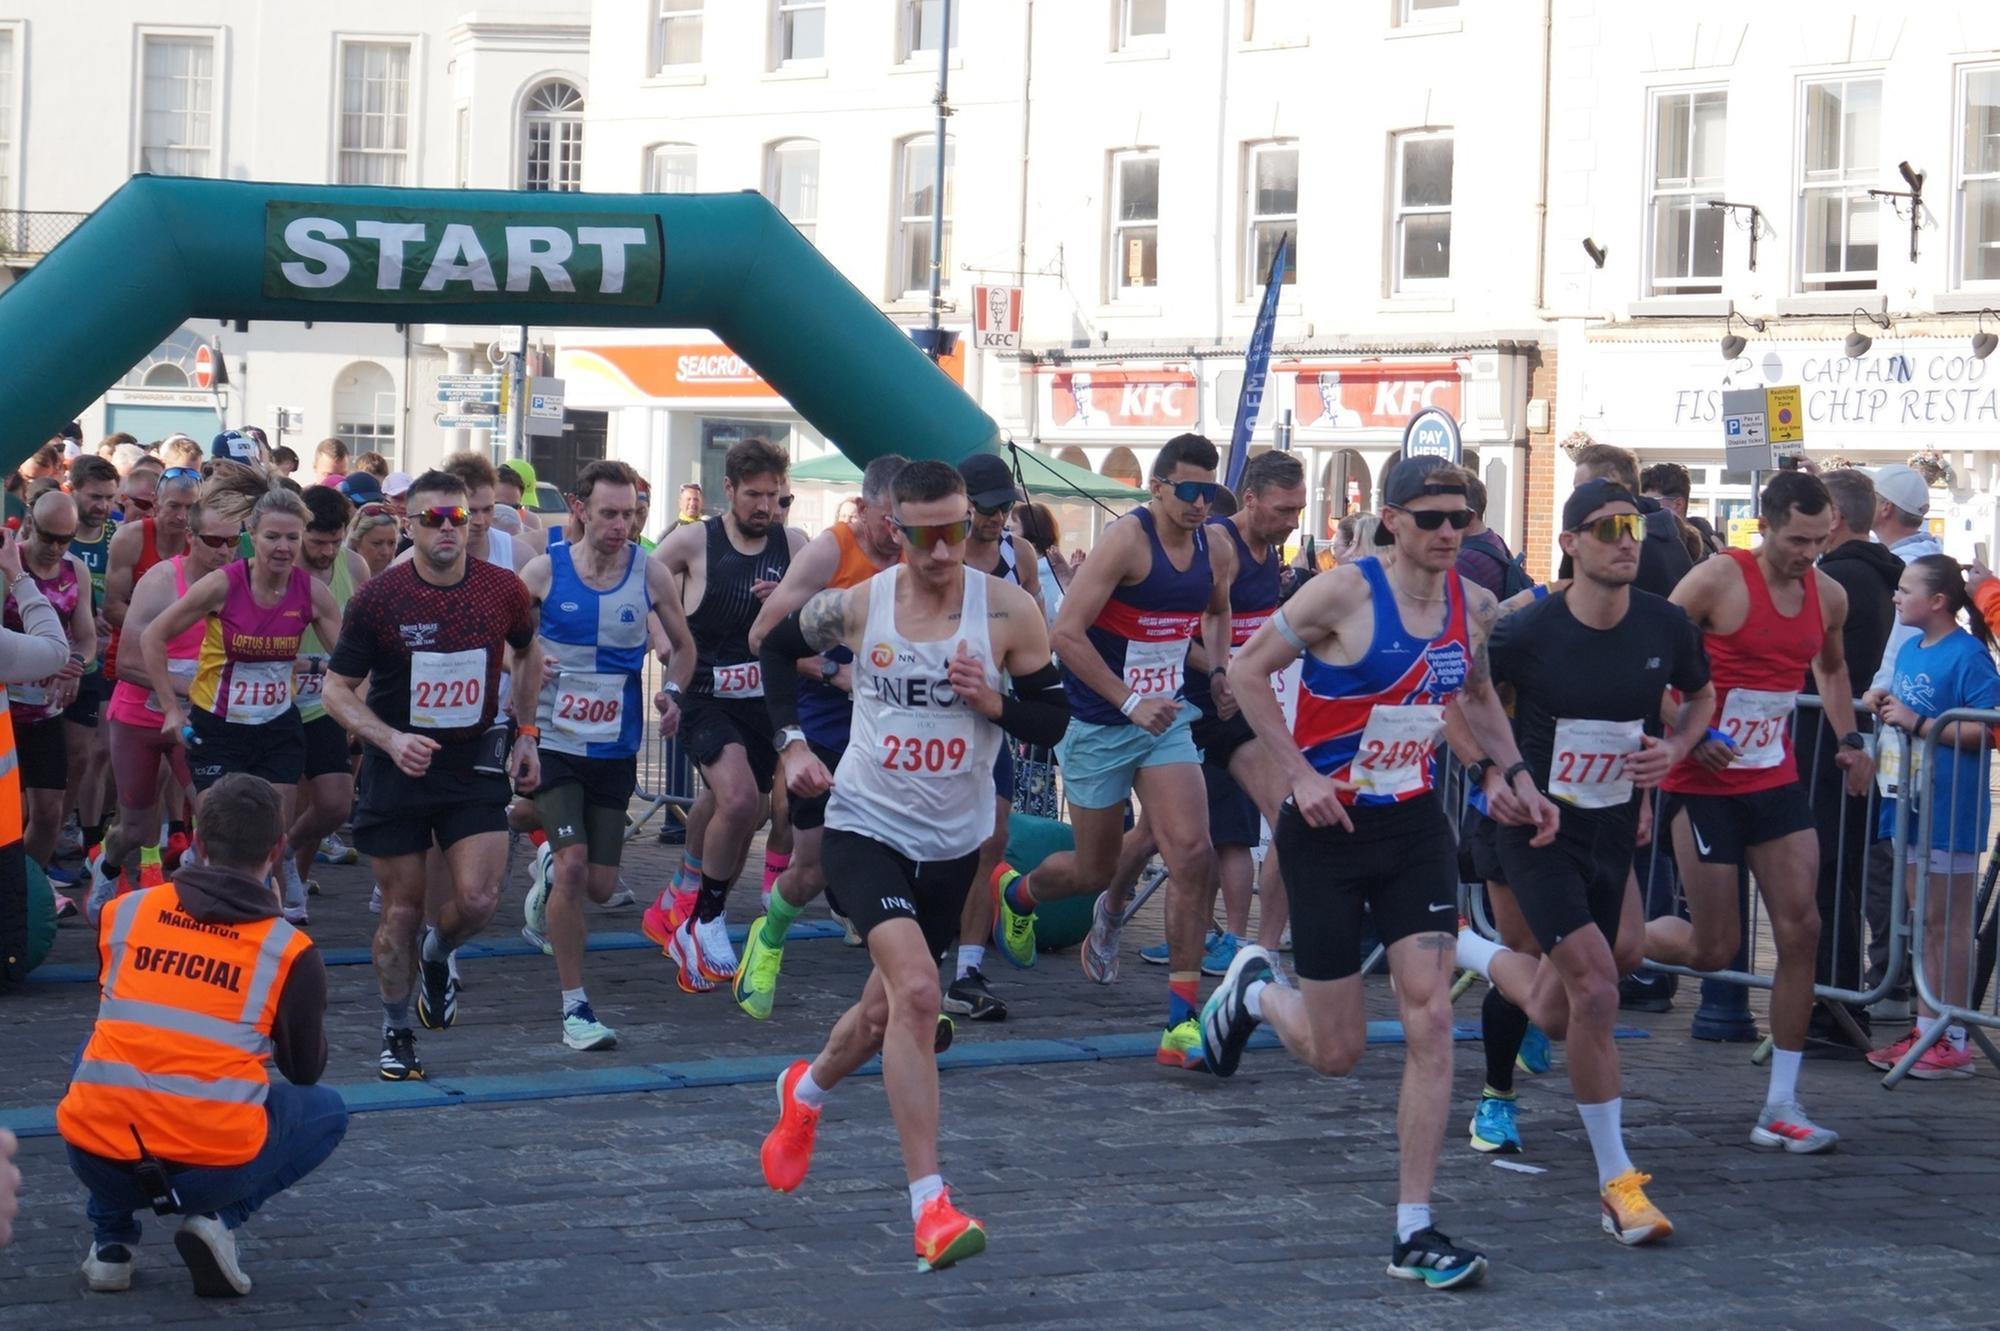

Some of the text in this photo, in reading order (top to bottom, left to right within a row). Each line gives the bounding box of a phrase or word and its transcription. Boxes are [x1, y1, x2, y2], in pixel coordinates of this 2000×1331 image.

[281, 217, 647, 293] START
[983, 333, 1013, 346] KFC
[1802, 355, 1985, 384] CAPTAIN COD
[534, 397, 543, 408] P
[1120, 382, 1187, 416] KFC
[1372, 380, 1447, 416] KFC
[1675, 390, 1722, 423] FIS
[1808, 389, 1888, 424] CHIP
[1419, 430, 1445, 445] PAY
[1729, 419, 1739, 434] P
[1414, 446, 1448, 457] HERE
[232, 633, 299, 649] LOFTUS & WHITB
[899, 654, 916, 663] NN
[1428, 651, 1463, 660] Nuneaton
[1432, 659, 1462, 667] Harriers
[1129, 664, 1177, 694] 2551
[1437, 667, 1465, 675] Athletic
[1441, 676, 1459, 685] Club
[234, 681, 287, 706] 2183
[416, 678, 480, 708] 2220
[873, 675, 968, 708] INEO
[558, 694, 619, 723] 2308
[1726, 715, 1784, 748] 2737
[882, 734, 967, 773] 2309
[1557, 752, 1628, 783] 2777
[881, 896, 917, 915] INE
[134, 946, 242, 993] OFFICIAL
